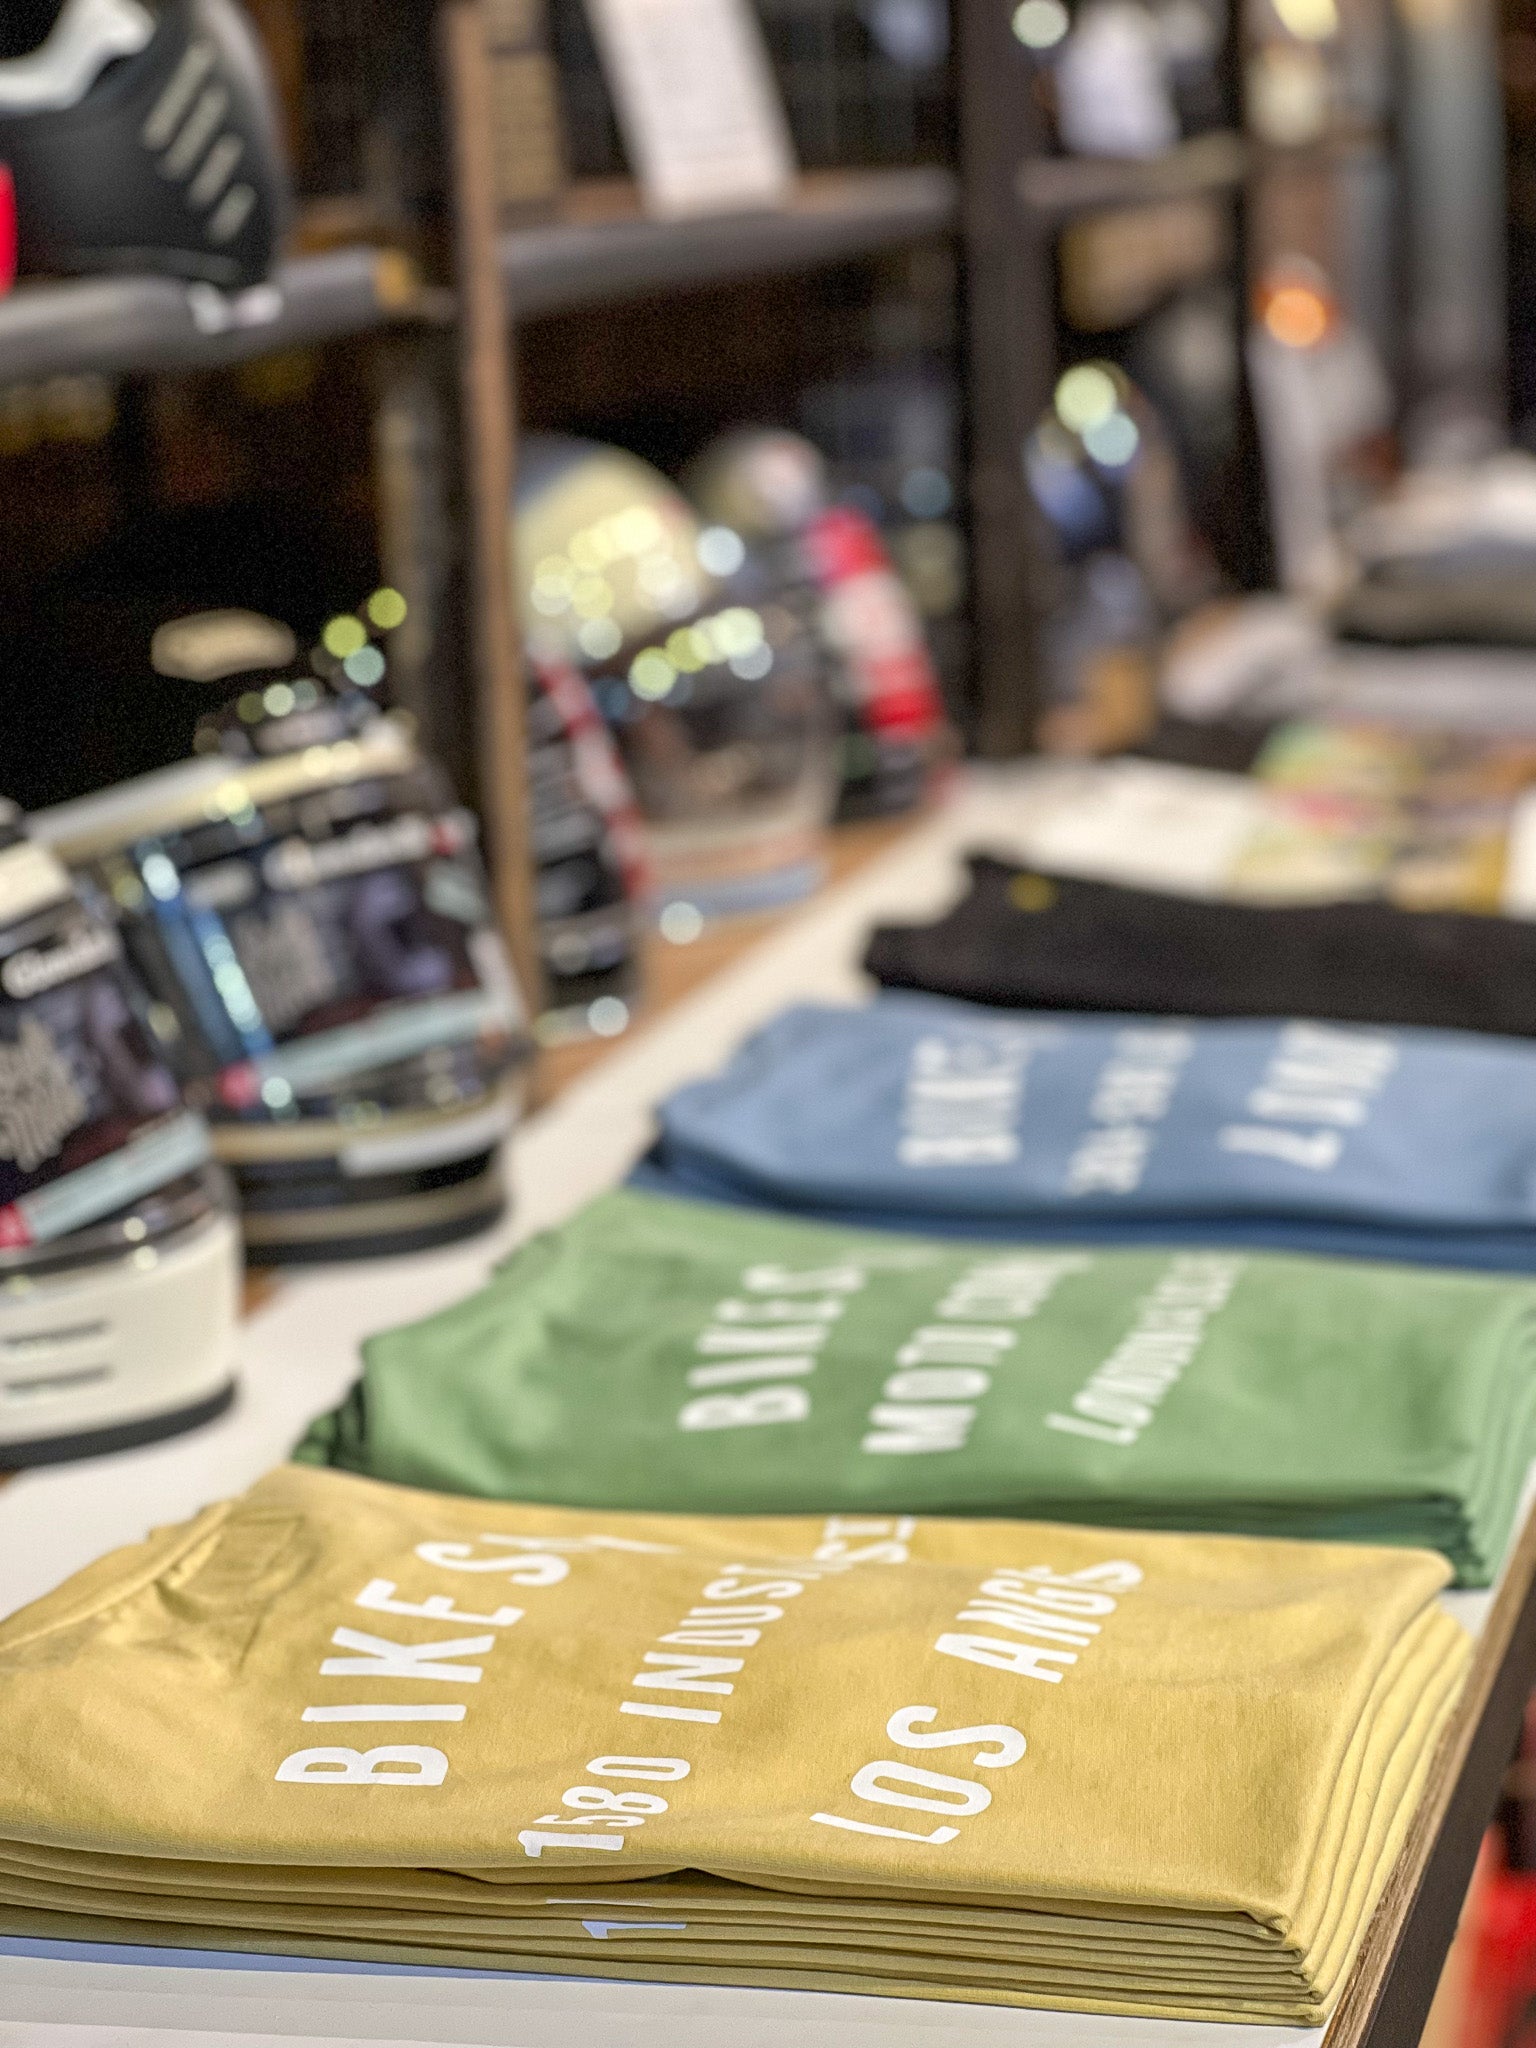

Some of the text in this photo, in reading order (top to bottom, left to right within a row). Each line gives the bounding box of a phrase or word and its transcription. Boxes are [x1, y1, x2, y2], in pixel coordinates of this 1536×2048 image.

[274, 1533, 672, 1786] BIKES
[517, 1755, 692, 1858] 1580
[808, 1704, 1027, 1845] LOS
